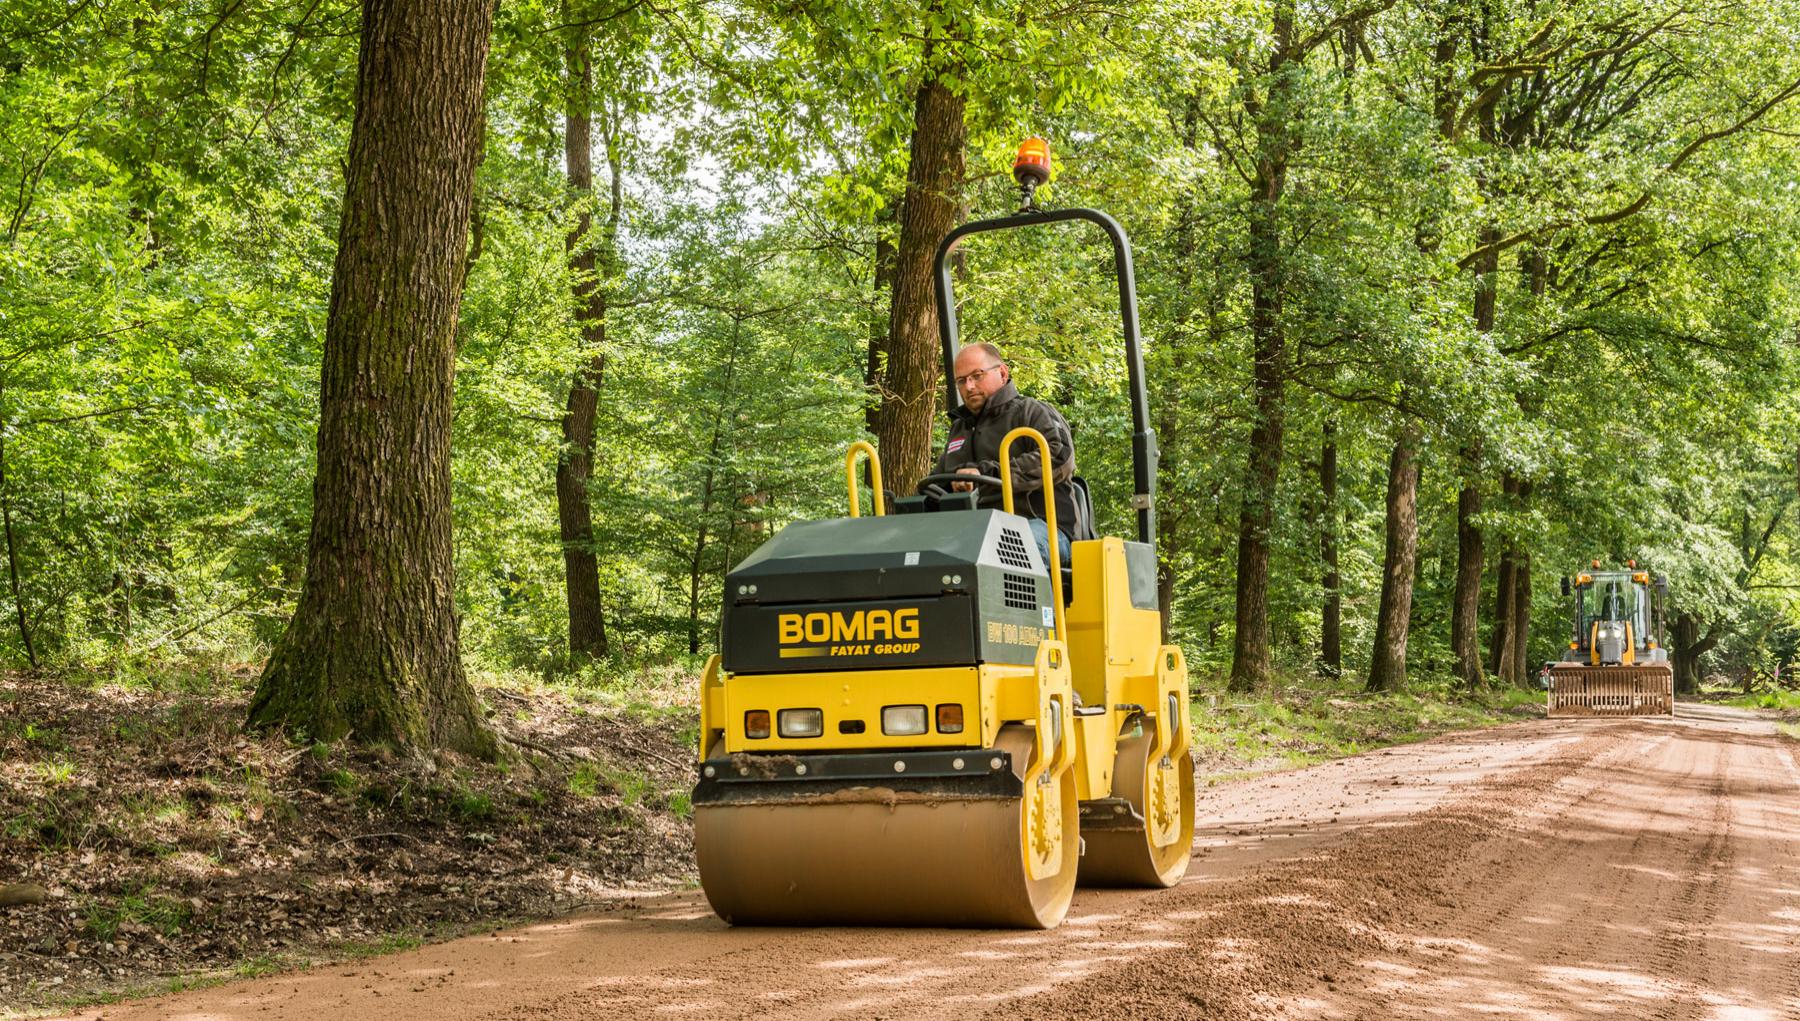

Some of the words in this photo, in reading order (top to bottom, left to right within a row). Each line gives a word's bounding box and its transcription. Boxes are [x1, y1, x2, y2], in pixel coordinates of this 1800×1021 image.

[779, 608, 920, 644] BOMAG
[1003, 623, 1018, 645] 100
[830, 645, 871, 656] FAYAT
[874, 643, 920, 655] GROUP
